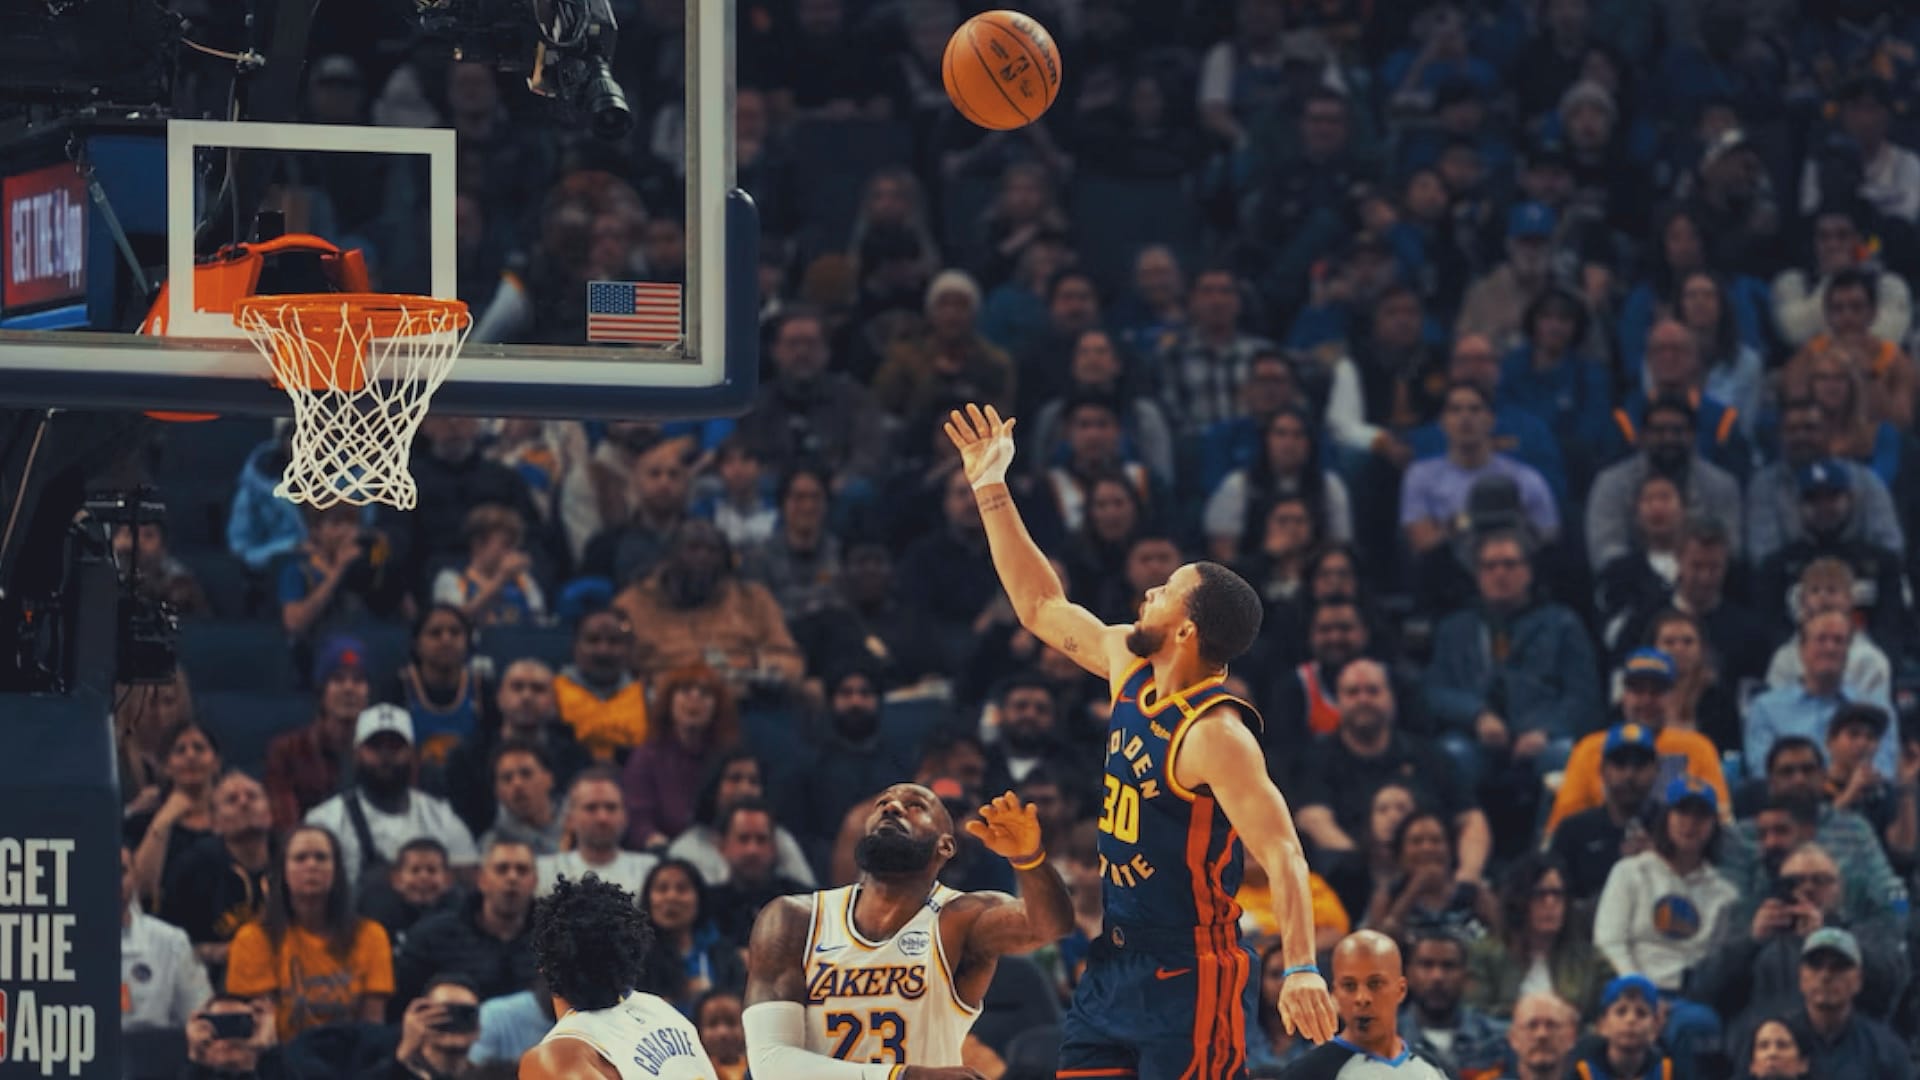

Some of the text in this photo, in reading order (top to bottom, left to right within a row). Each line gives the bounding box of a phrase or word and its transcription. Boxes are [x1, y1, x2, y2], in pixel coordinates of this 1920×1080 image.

[1105, 727, 1160, 799] ODEN
[1098, 773, 1140, 844] 30
[0, 837, 76, 906] GET
[1098, 853, 1155, 887] TATE
[0, 913, 76, 981] THE
[806, 962, 927, 1005] LAKERS
[12, 990, 96, 1076] App
[633, 1027, 696, 1076] CHRISTIE
[824, 1008, 907, 1065] 23
